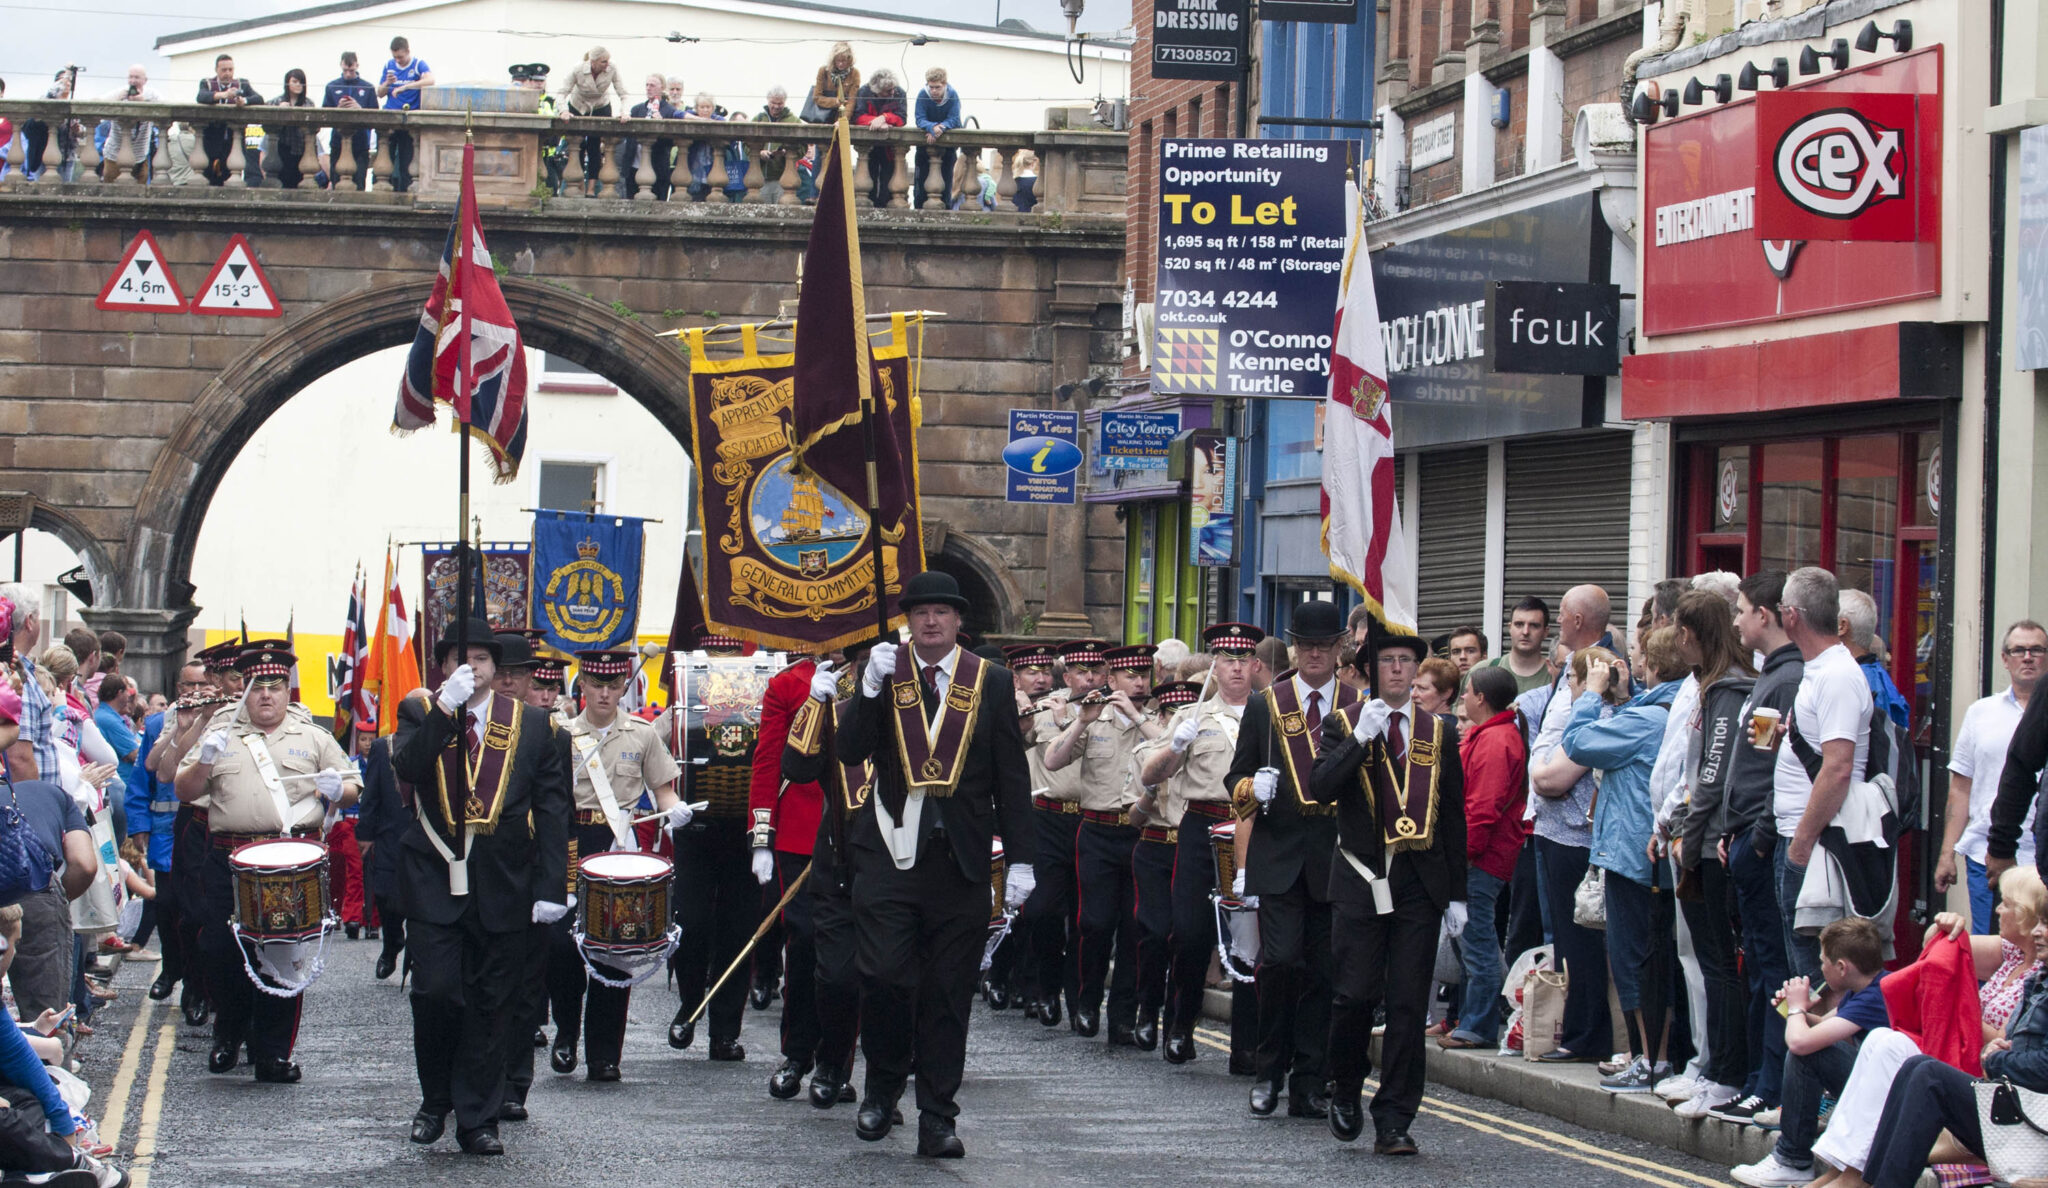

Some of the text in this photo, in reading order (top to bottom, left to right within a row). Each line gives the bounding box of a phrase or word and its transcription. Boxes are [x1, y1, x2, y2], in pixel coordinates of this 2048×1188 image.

[1156, 11, 1238, 31] DRESSING
[1161, 48, 1231, 62] 71308502
[1165, 143, 1328, 162] Prime Retailing
[1165, 167, 1281, 186] Opportunity
[1163, 194, 1297, 225] To Let
[1656, 186, 1755, 246] ENTERTAINMENT
[1164, 236, 1203, 249] 1,695
[1206, 239, 1223, 250] sq
[1227, 236, 1239, 248] ft
[1250, 236, 1276, 248] 158
[1164, 258, 1190, 270] 520
[1194, 261, 1211, 272] sq
[1215, 258, 1226, 270] ft
[1238, 258, 1255, 270] 48
[1160, 290, 1278, 308] 7034 4244
[1160, 311, 1227, 324] okt.co.uk
[1509, 308, 1604, 346] fcuk
[1229, 330, 1332, 349] O'Conno
[1380, 300, 1485, 372] NCH CONNE
[1228, 352, 1330, 376] Kennedy
[1227, 375, 1295, 393] Turtle
[721, 383, 794, 427] APPRENTICE
[1016, 420, 1073, 435] City Tours
[1105, 420, 1175, 438] City Tours
[720, 431, 784, 462] ASSOCIATED
[1109, 446, 1169, 455] Tickets Here
[1104, 456, 1126, 468] £4
[1028, 477, 1057, 485] VISITOR
[1226, 439, 1236, 512] HAIRDRESSERS
[1016, 485, 1069, 493] INFORMATION
[740, 558, 888, 601] GENERAL COMMITTE
[1702, 716, 1729, 784] HOLLISTER
